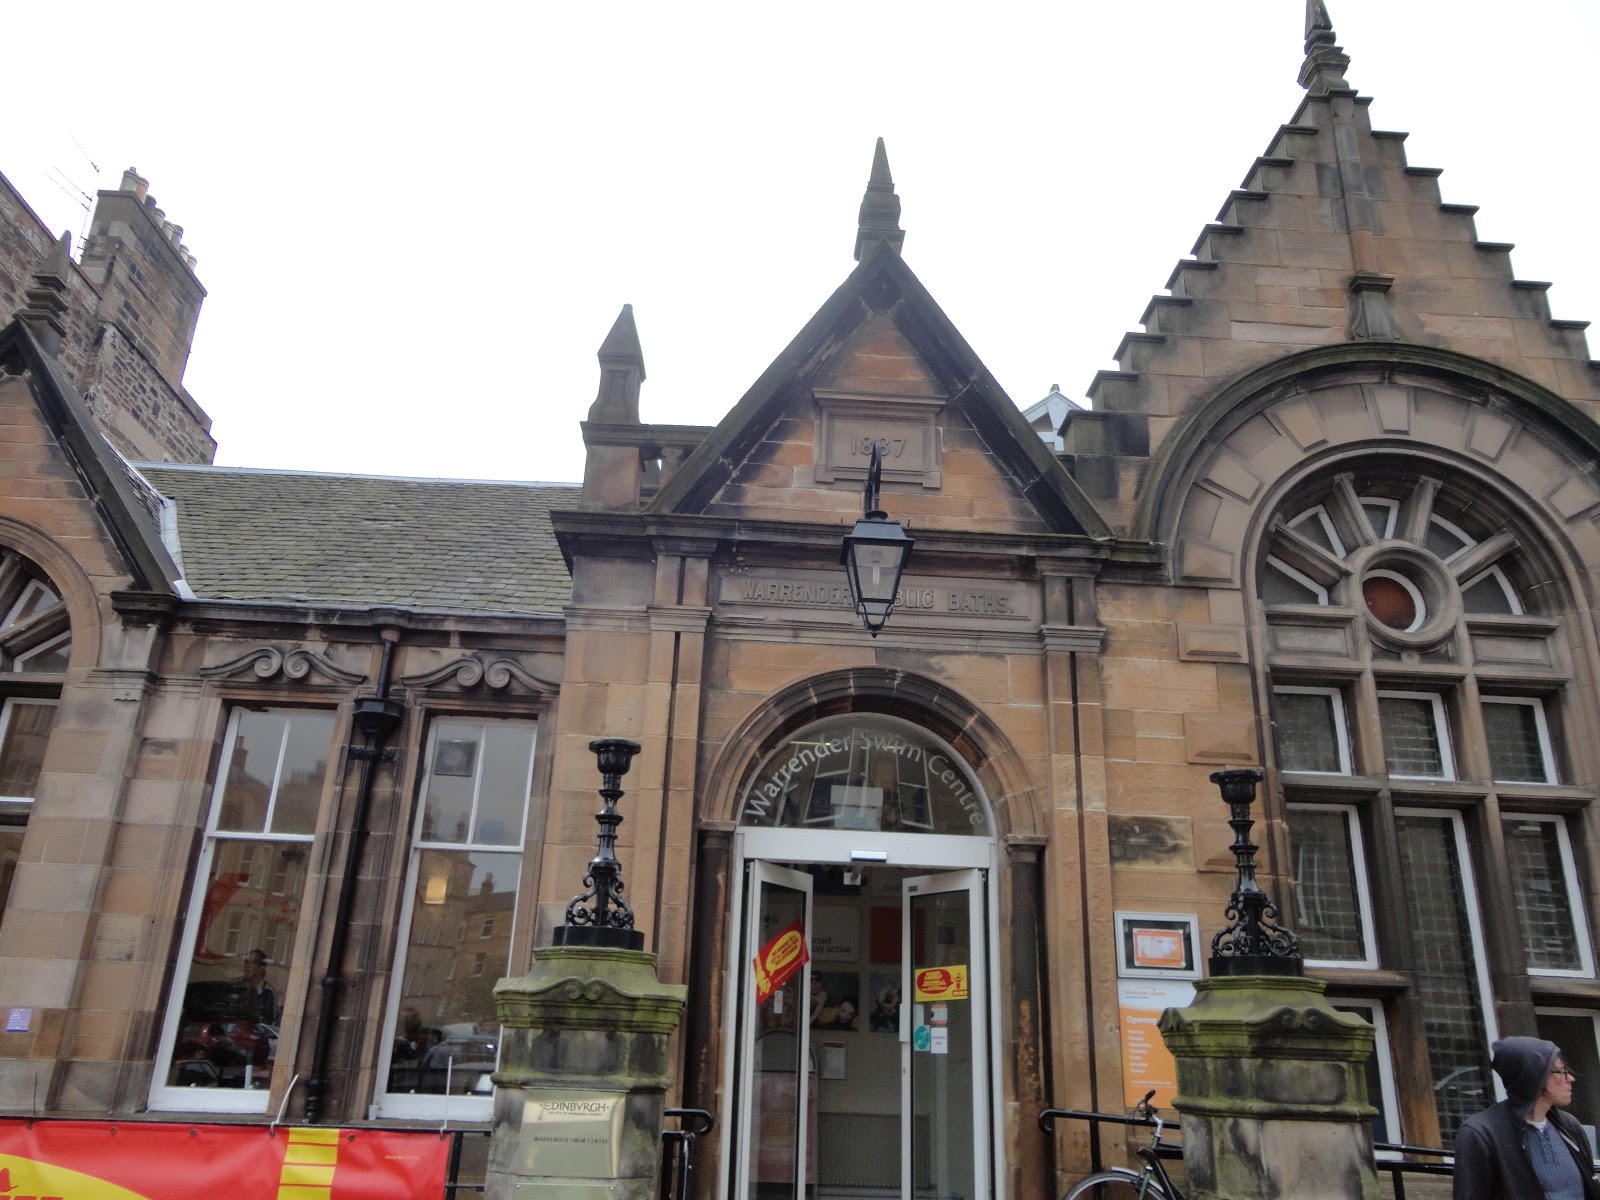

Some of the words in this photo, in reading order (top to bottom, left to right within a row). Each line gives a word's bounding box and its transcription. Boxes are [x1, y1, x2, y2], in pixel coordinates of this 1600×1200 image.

[742, 580, 854, 607] WARRENDER
[743, 731, 852, 818] Warrender
[860, 728, 923, 762] Swim
[927, 753, 986, 826] Centre
[1126, 1015, 1157, 1026] Opening
